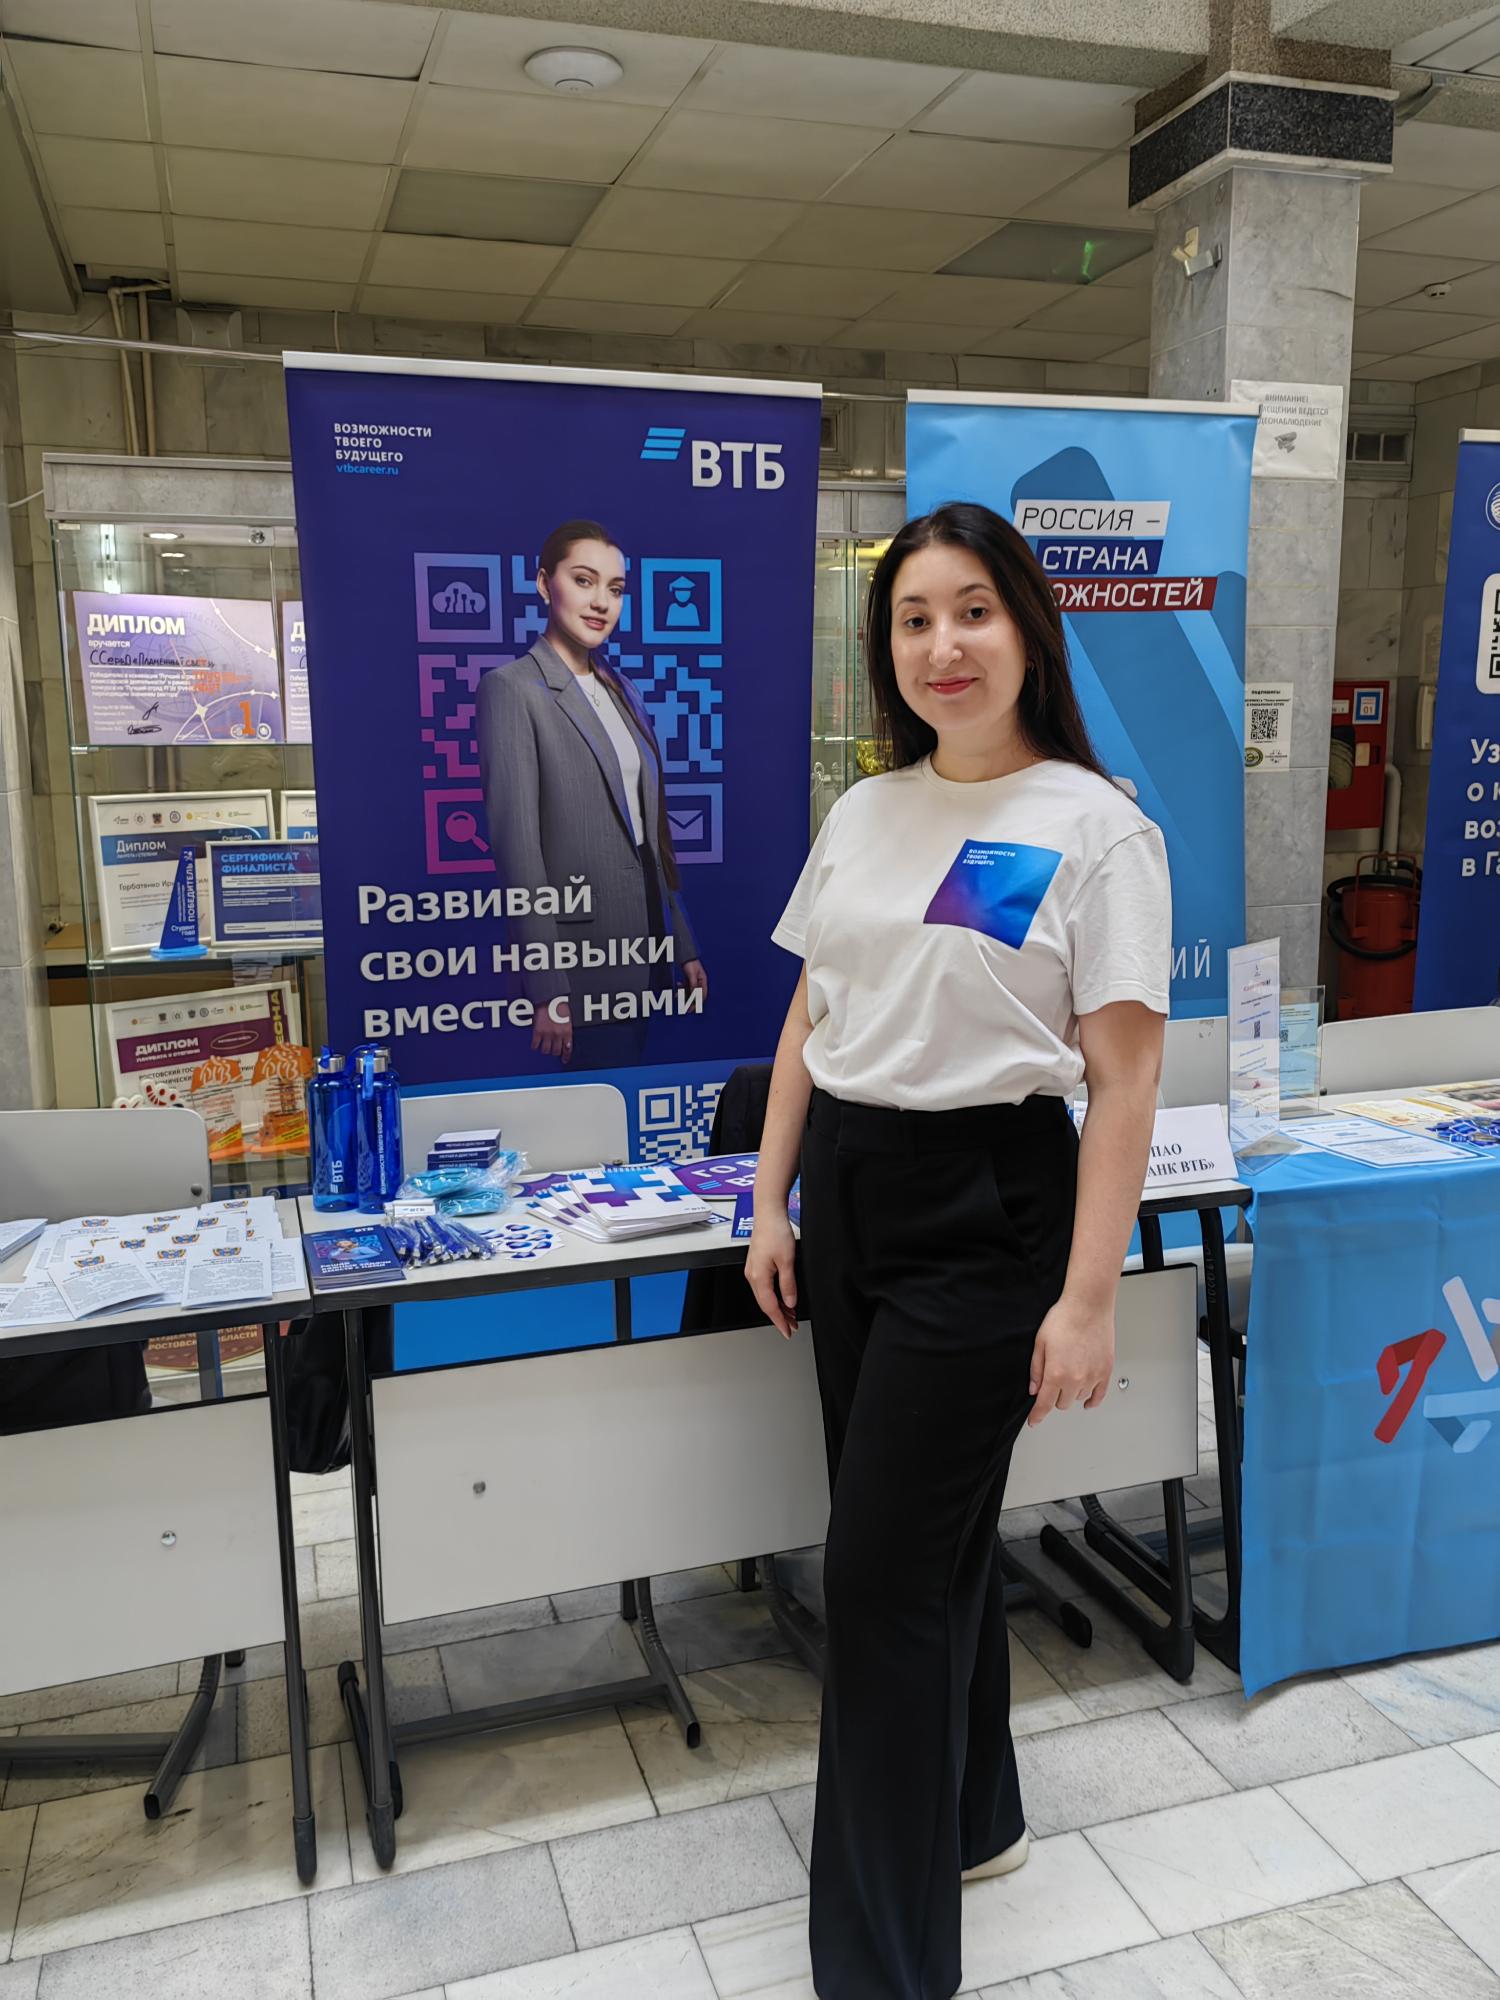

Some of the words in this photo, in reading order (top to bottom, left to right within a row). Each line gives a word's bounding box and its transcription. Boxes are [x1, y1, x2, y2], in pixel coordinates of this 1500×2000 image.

[1265, 394, 1309, 403] ВНИМАНИЕ!
[1298, 407, 1329, 417] ВЕДЕТСЯ
[334, 423, 432, 438] ВОЗМОЖНОСТИ
[1258, 417, 1322, 427] ДЕОНАБЛЮДЕНИЕ
[335, 437, 382, 449] ТВОЕГО
[336, 450, 404, 464] БУДУЩЕГО
[691, 440, 785, 490] ВТБ
[336, 464, 399, 476] vtbcareer.ru
[1021, 507, 1134, 532] РОССИЯ
[1042, 546, 1149, 571] СТРАНА
[1052, 577, 1203, 607] ОЖНОСТЕЙ
[87, 614, 185, 636] ДИПЛОМ
[1363, 706, 1374, 714] 01
[1471, 738, 1500, 764] Уз
[1467, 782, 1484, 802] о
[116, 841, 167, 854] Диплом
[221, 852, 299, 862] СЕРТИФИКАТ
[222, 863, 295, 873] ФИНАЛИСТА
[1462, 858, 1476, 877] в
[119, 880, 161, 891] Горбатенко
[186, 863, 196, 922] ПОБЕДИТЕЛЬ
[358, 875, 593, 924] Развивай
[360, 946, 476, 982] свои
[492, 935, 675, 973] навыки
[272, 990, 284, 1043] ЕСНА
[364, 998, 534, 1038] вместе
[548, 995, 570, 1025] с
[583, 987, 704, 1022] нами
[135, 1037, 199, 1056] ДИПЛОМ
[1151, 1143, 1182, 1158] ПАО
[332, 1160, 344, 1183] ВТБ
[1148, 1164, 1177, 1177] АНК
[1181, 1158, 1215, 1174] ВТБ»
[148, 1339, 197, 1350] РОСТОВСК
[220, 1331, 258, 1342] БЛАСТИ
